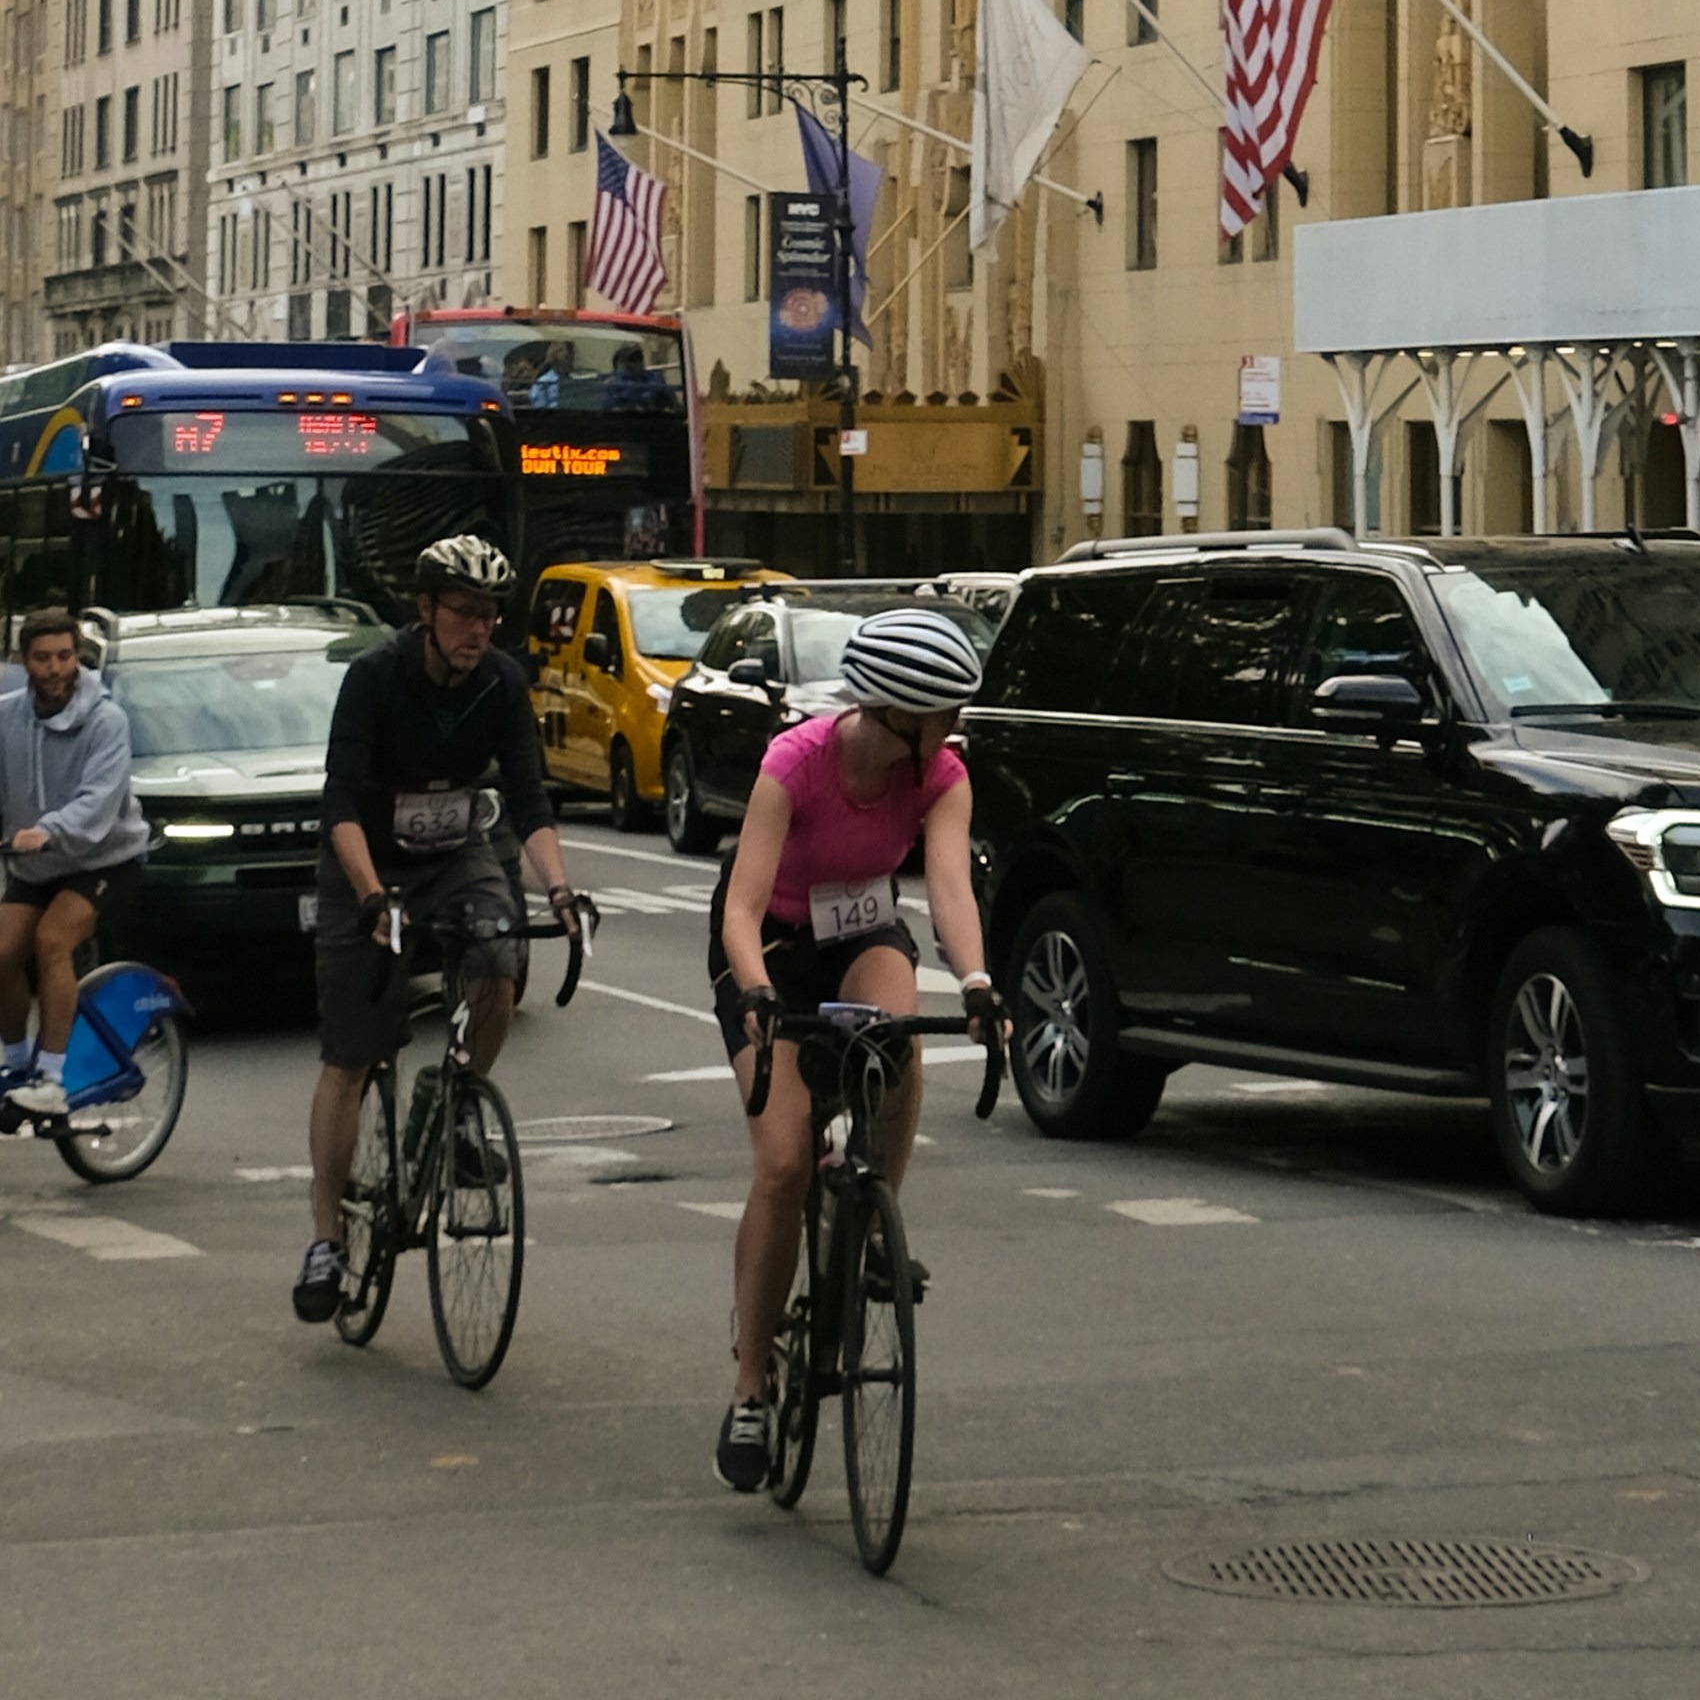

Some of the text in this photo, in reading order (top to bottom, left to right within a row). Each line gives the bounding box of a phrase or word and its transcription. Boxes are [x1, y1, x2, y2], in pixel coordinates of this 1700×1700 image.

[562, 460, 608, 475] TOUR
[240, 819, 322, 835] BRO
[410, 808, 458, 835] 632
[831, 896, 879, 934] 149
